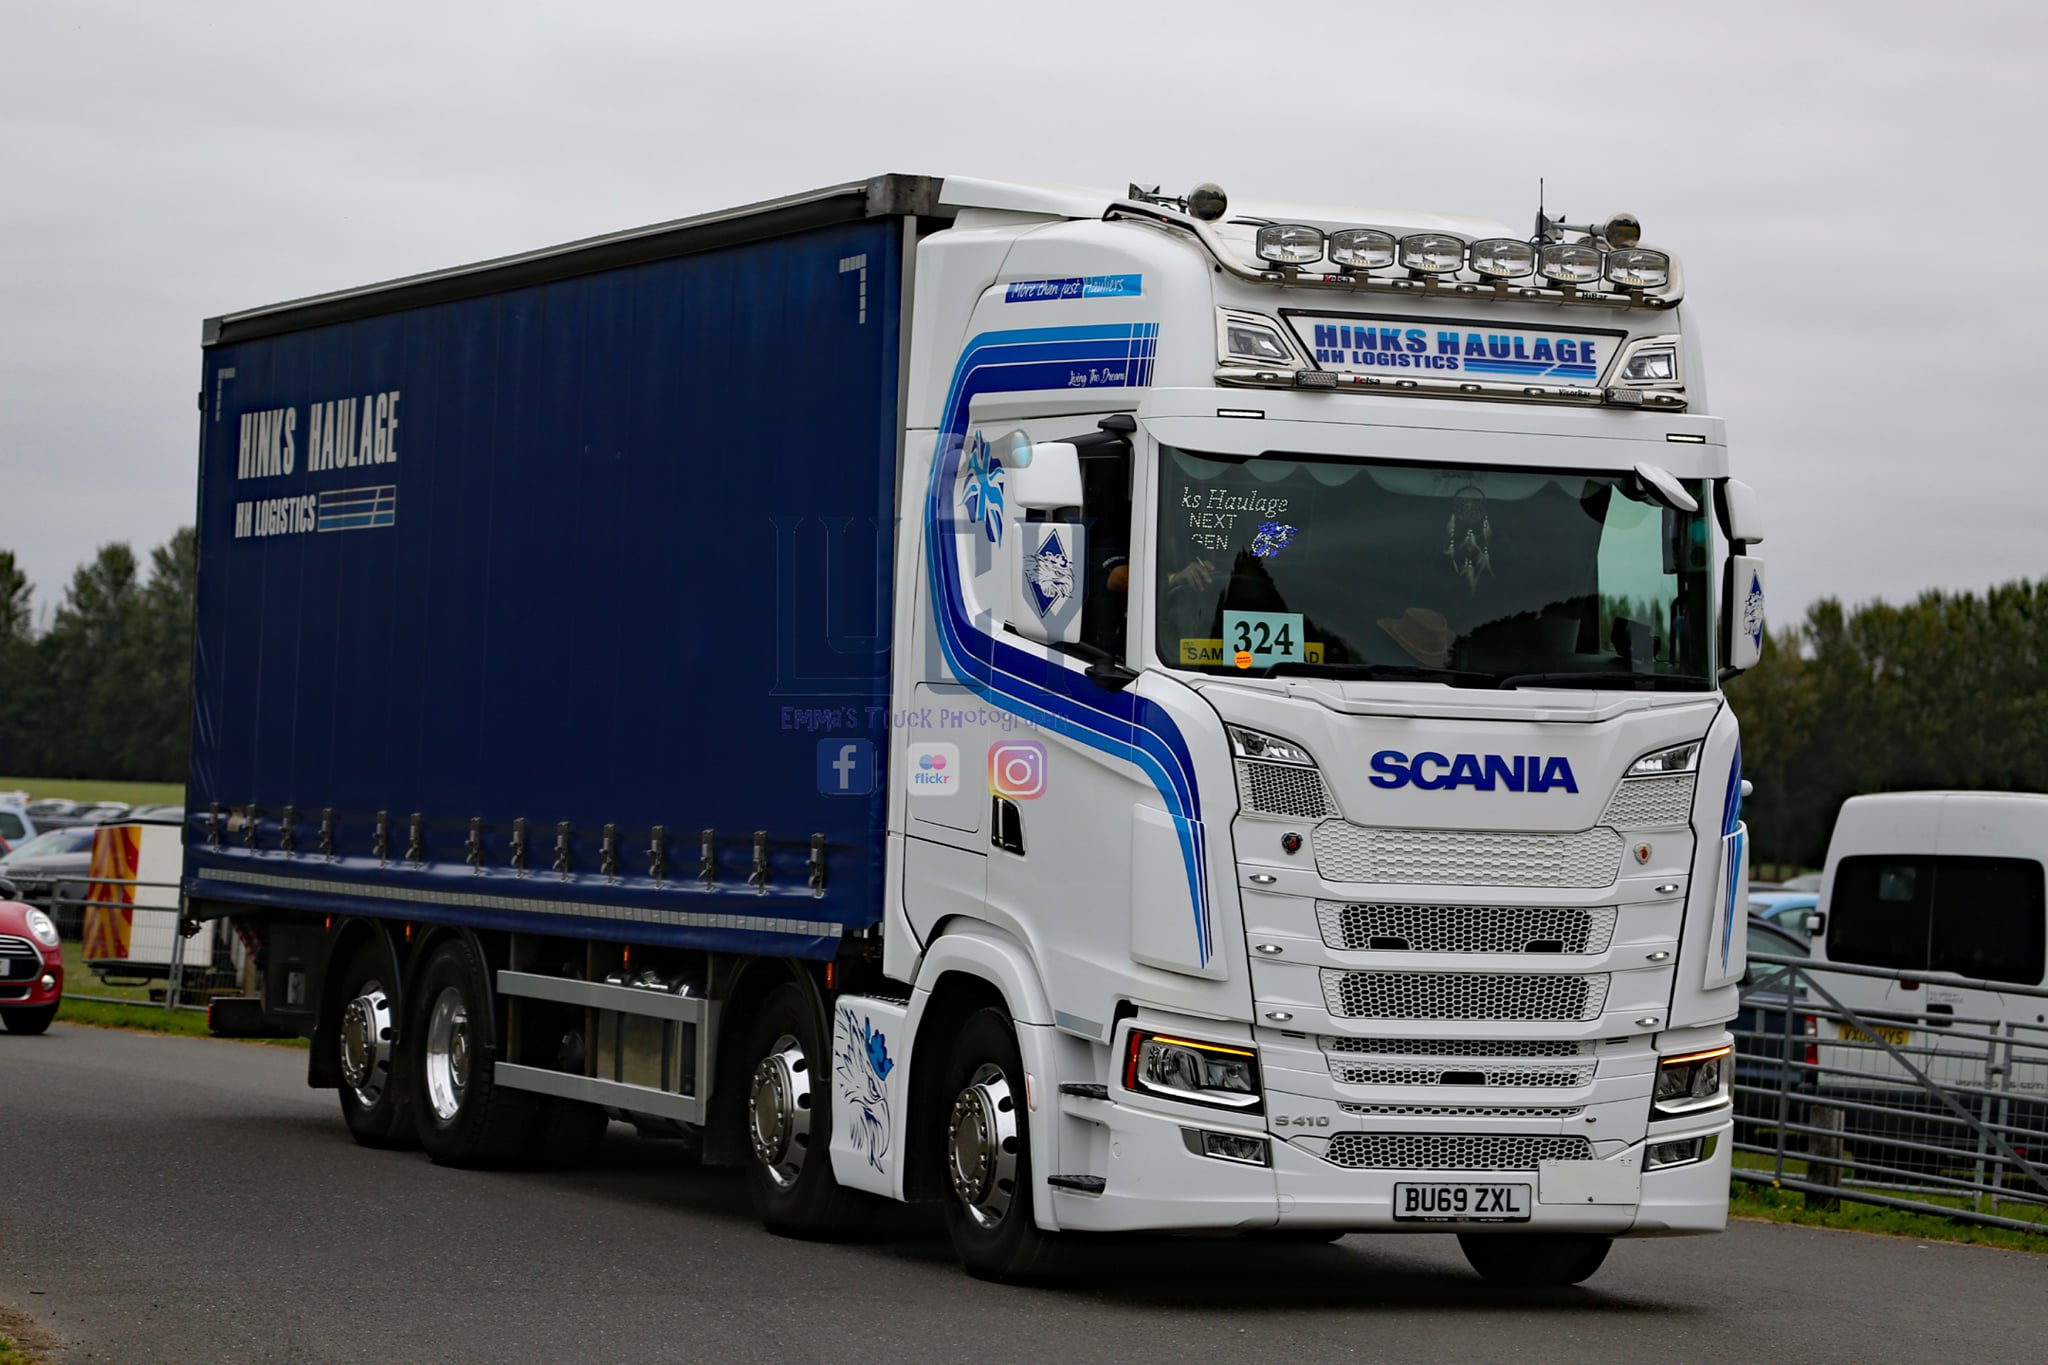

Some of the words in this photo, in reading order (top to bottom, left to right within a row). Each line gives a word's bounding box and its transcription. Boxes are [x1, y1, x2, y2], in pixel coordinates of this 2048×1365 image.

[1011, 282, 1034, 299] More
[1037, 281, 1058, 297] than
[1059, 279, 1081, 300] just
[1314, 324, 1427, 353] HINKS
[1437, 331, 1597, 365] HAULAGE
[1316, 349, 1345, 364] HH
[1352, 351, 1459, 370] LOGISTICS
[1100, 368, 1125, 384] Dream
[237, 406, 297, 481] HINKS
[307, 390, 401, 473] HAULAGE
[234, 502, 253, 539] HH
[254, 494, 317, 538] LOGISTICS
[1206, 489, 1289, 519] Haulage
[1189, 512, 1238, 529] NEXT
[1233, 620, 1294, 656] 324
[1368, 750, 1579, 794] SCANIA
[1275, 1115, 1289, 1126] S
[1291, 1115, 1330, 1127] 410
[1405, 1187, 1468, 1213] BU69
[1474, 1188, 1520, 1213] ZXL
